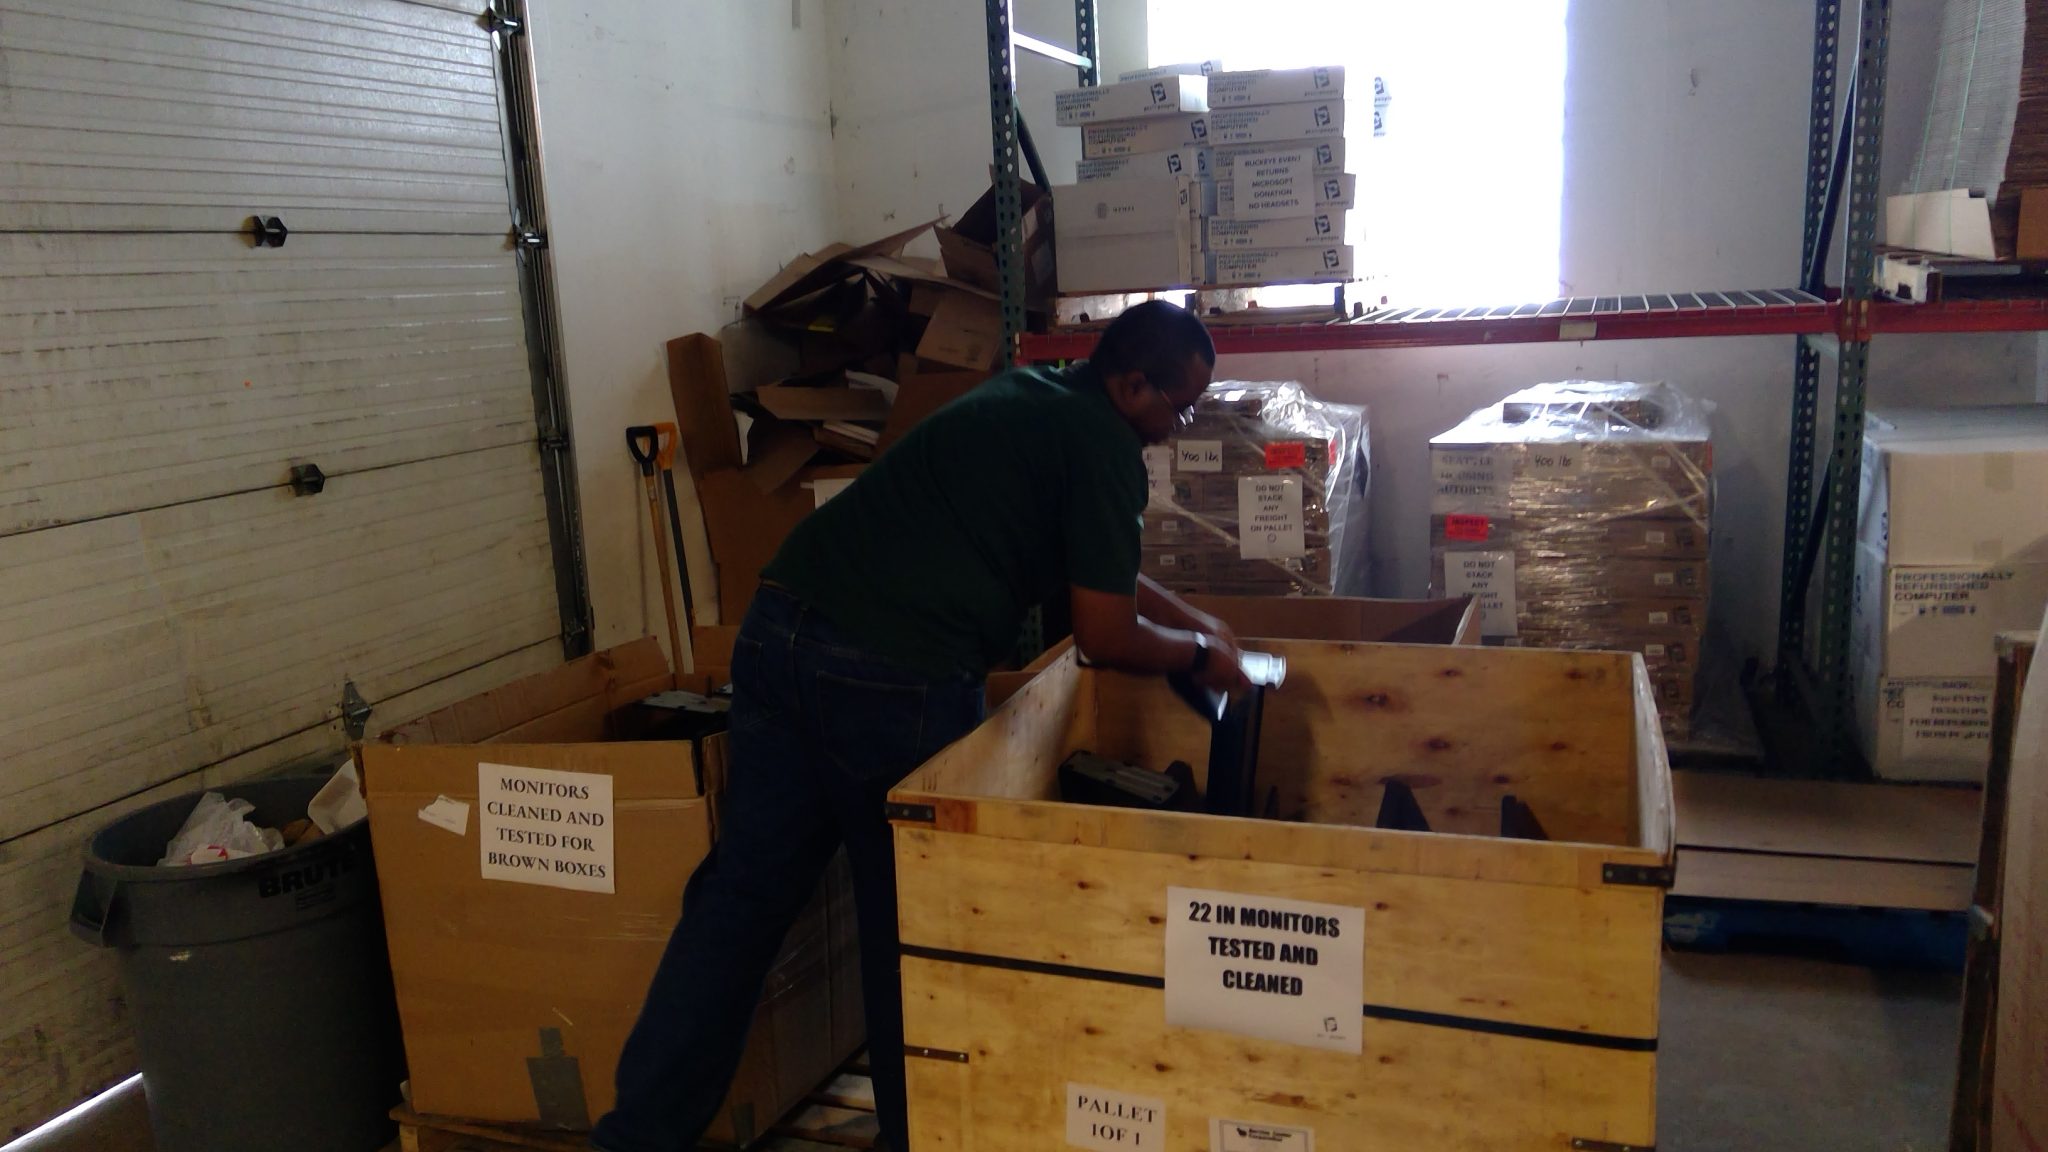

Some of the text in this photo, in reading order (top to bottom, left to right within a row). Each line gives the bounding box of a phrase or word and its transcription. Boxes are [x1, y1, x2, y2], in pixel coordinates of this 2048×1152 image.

[1244, 158, 1277, 167] BUCKEYE
[1279, 155, 1302, 164] EVENT
[1256, 168, 1289, 177] RETURNS
[1251, 178, 1294, 188] MICROSOFT
[1254, 189, 1293, 199] DONATION
[1248, 199, 1300, 210] NO HEADSETS
[1255, 484, 1284, 492] DO NOT
[1258, 494, 1284, 502] STACK
[1262, 504, 1279, 512] ANY
[1254, 514, 1288, 522] FREIGHT
[1250, 523, 1293, 533] ON PALLET
[1463, 560, 1496, 568] DO NOT
[1894, 571, 2015, 582] PROFESSIONALLY
[1894, 581, 1990, 591] REFURBISHED
[1894, 591, 1969, 601] COMPUTER
[500, 777, 590, 801] MONITORS
[487, 801, 605, 828] CLEANED AND
[497, 827, 596, 853] TESTED FOR
[488, 851, 606, 879] BROWN BOXES
[1188, 900, 1341, 939] 22 IN MONITORS
[1208, 935, 1319, 967] TESTED AND
[1222, 969, 1304, 997] CLEANED
[1077, 1094, 1157, 1124] PALLET
